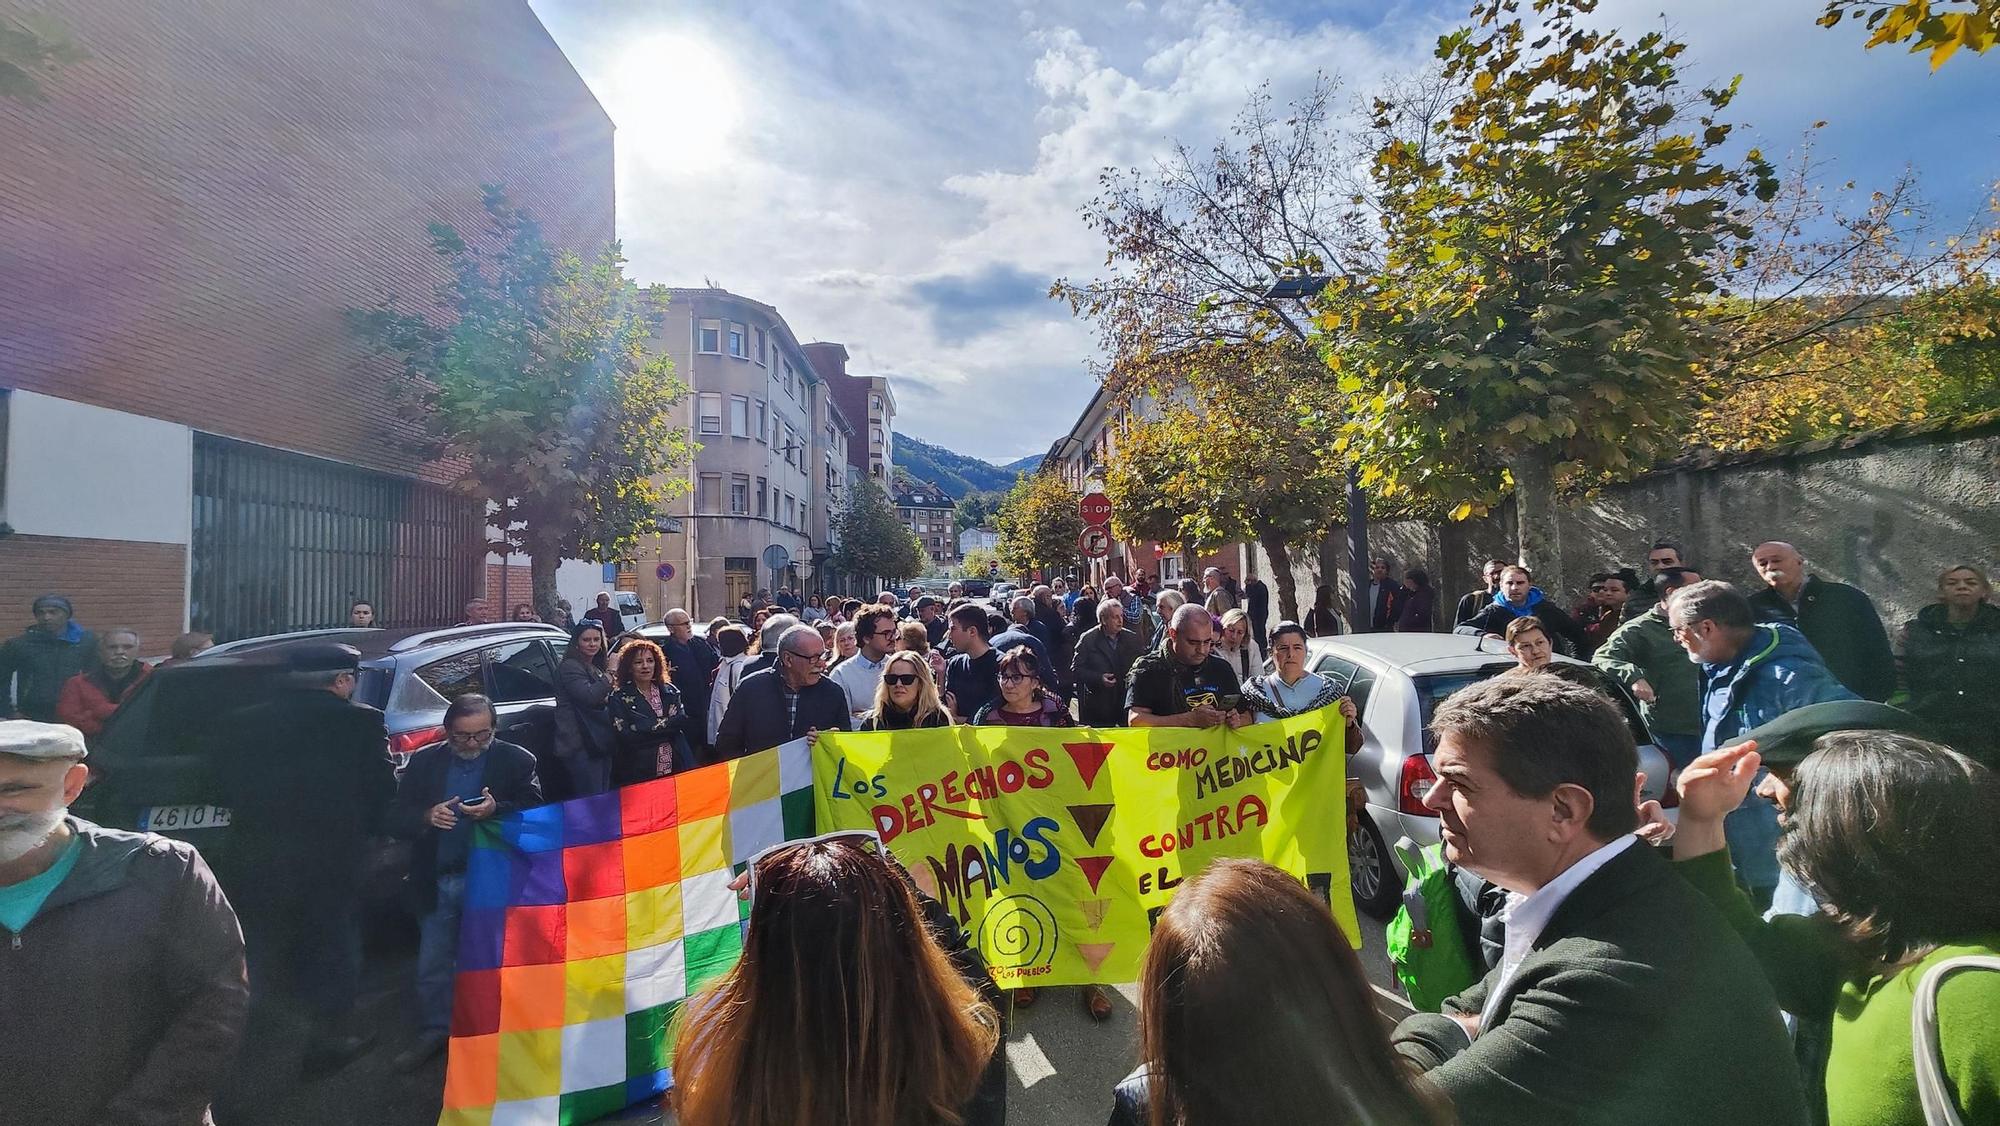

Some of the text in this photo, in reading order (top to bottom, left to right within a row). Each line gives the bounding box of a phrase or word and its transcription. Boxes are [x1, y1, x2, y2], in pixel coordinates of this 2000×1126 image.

[1082, 505, 1110, 513] STOP
[1146, 748, 1208, 771] COMO
[871, 749, 1054, 844] DERECHOS
[153, 807, 205, 826] 4610
[1139, 795, 1268, 858] CONTRA
[1139, 867, 1184, 895] EL
[1017, 965, 1051, 977] PUEBLOS
